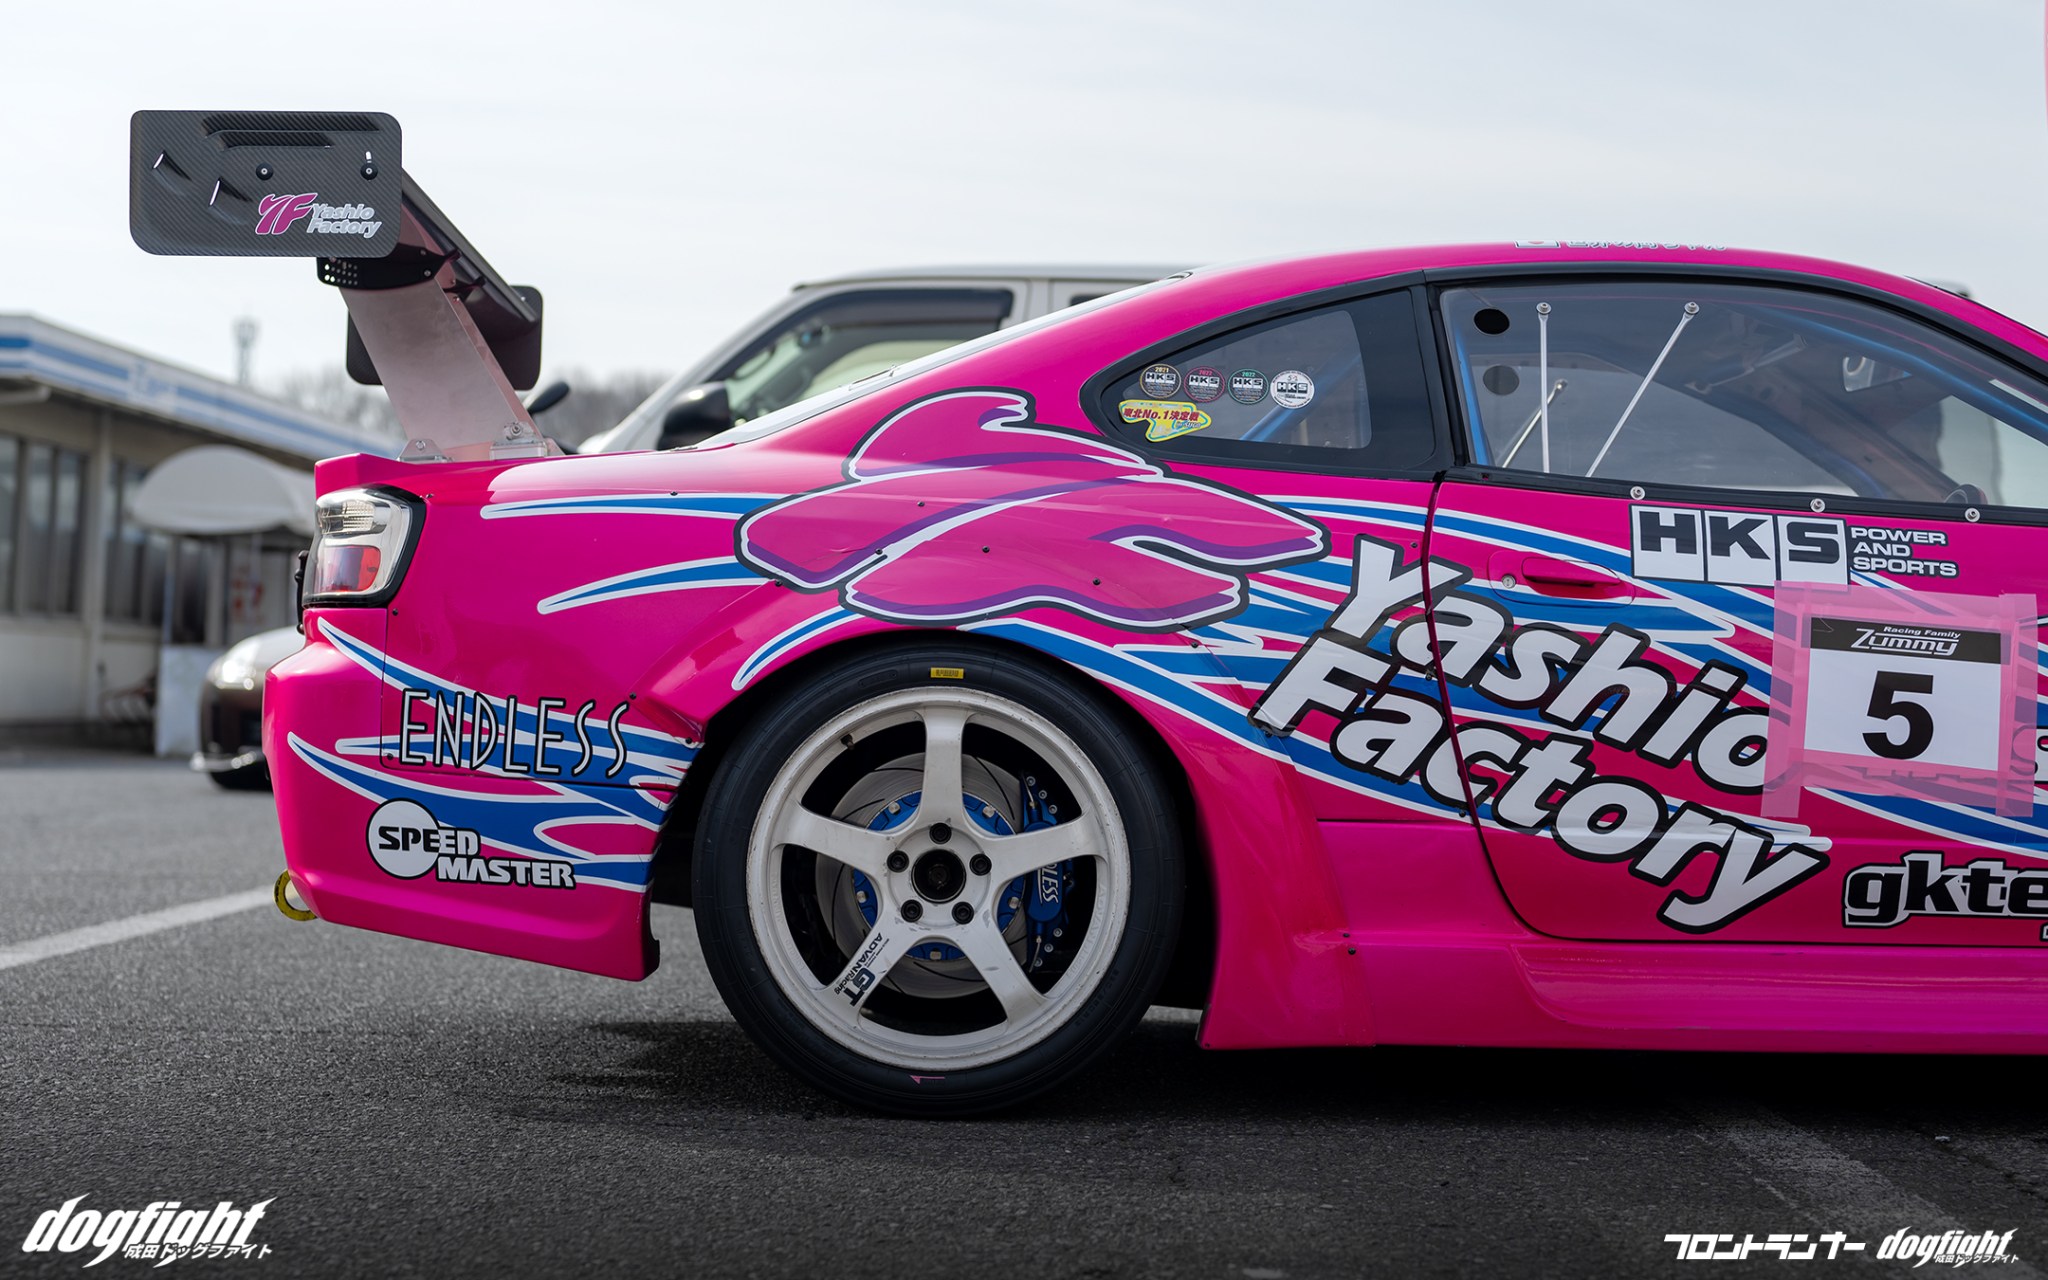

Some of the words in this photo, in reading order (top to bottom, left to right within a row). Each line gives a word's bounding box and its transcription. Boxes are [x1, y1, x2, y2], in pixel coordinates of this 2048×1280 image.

[312, 203, 375, 220] Yashio
[306, 218, 382, 238] Factory
[1145, 372, 1176, 385] HKS
[1189, 375, 1220, 387] HKS
[1233, 377, 1263, 389] HKS
[1277, 382, 1309, 394] HKS
[1636, 509, 1844, 570] HKS
[1850, 527, 1947, 545] POWER
[1853, 543, 1911, 558] AND
[1852, 556, 1957, 577] SPORTS
[1850, 627, 1958, 657] Zummy
[1883, 626, 1923, 637] Racing
[1924, 628, 1961, 640] Family
[1328, 534, 1786, 792] Yashio
[1862, 670, 1934, 760] 5
[400, 688, 631, 778] ENDLESS
[1250, 635, 1826, 929] Factory
[377, 825, 480, 856] SPEED
[437, 859, 576, 888] MASTER
[852, 932, 883, 973] ADVAN
[833, 970, 856, 995] Racing
[843, 967, 876, 1007] GT
